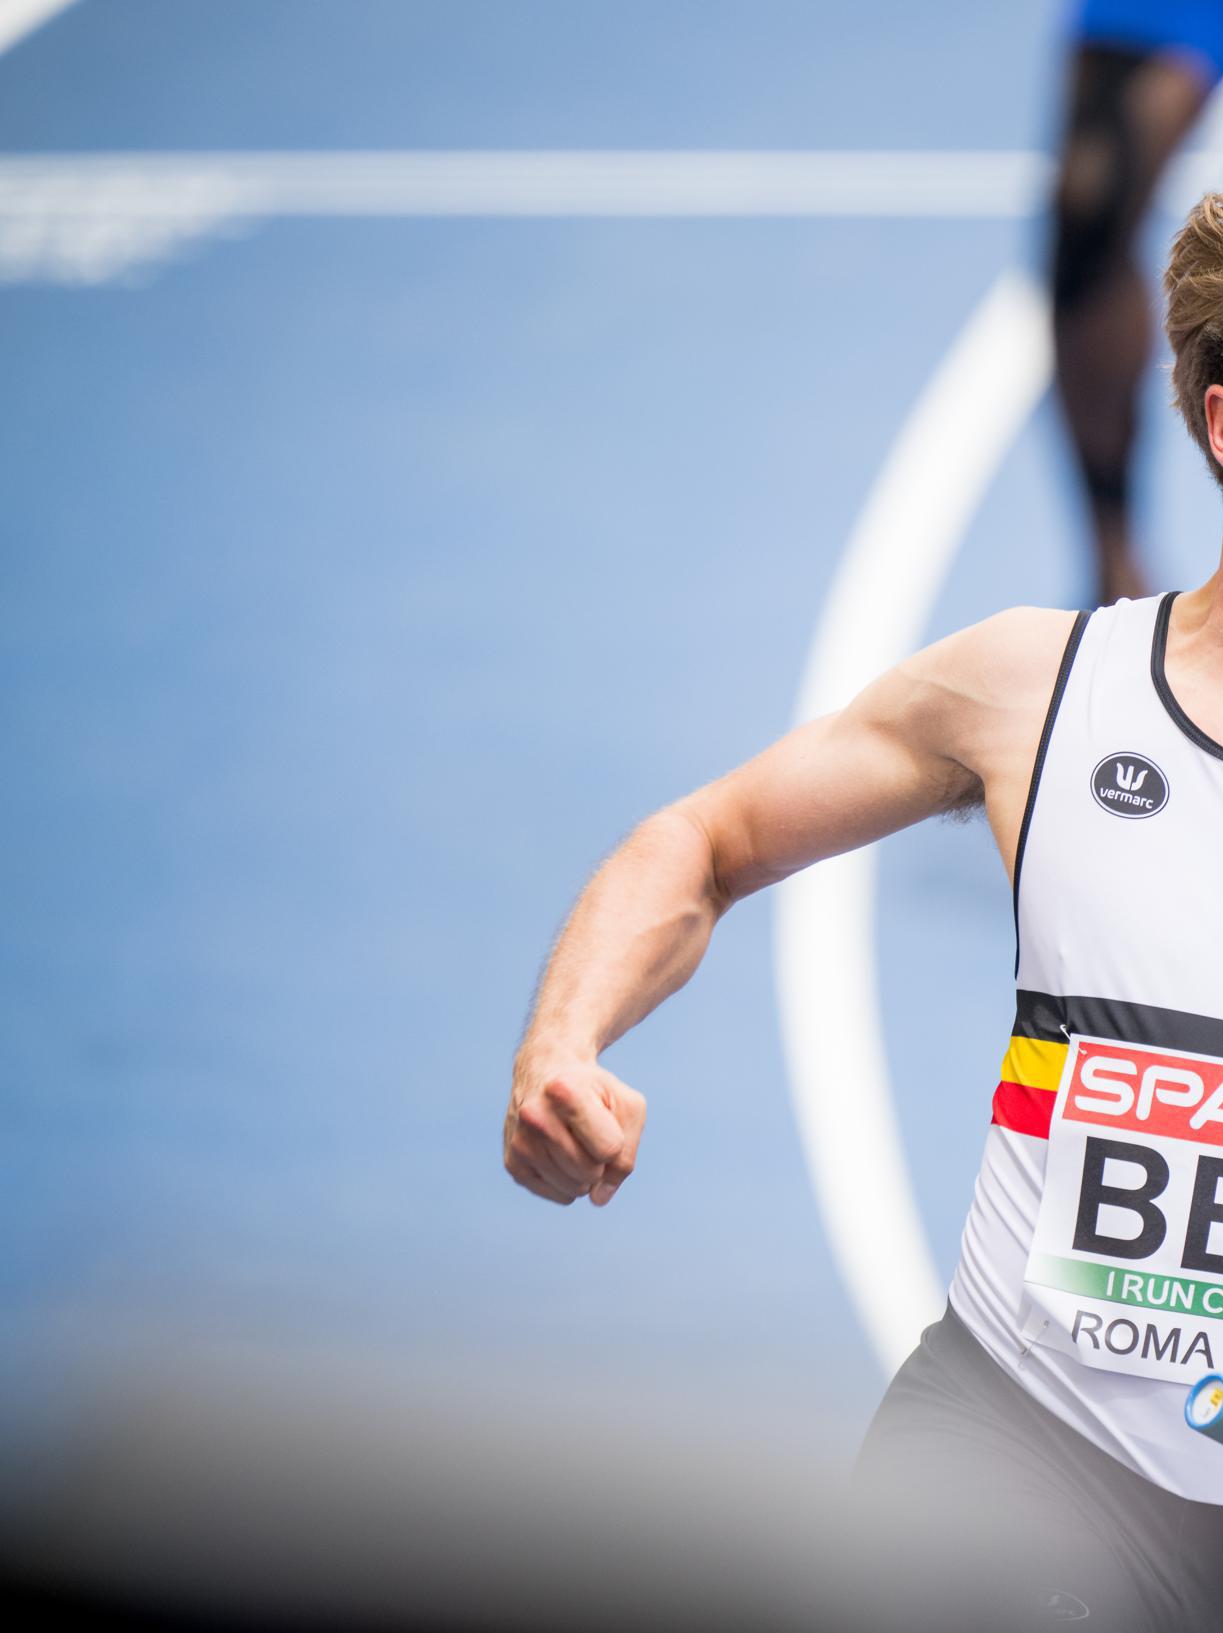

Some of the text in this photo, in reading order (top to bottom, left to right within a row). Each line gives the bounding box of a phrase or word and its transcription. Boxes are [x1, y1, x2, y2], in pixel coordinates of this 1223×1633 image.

[1100, 787, 1154, 810] vermarc
[1106, 1271, 1116, 1297] I
[1121, 1273, 1196, 1310] RUN
[1071, 1309, 1215, 1370] ROMA
